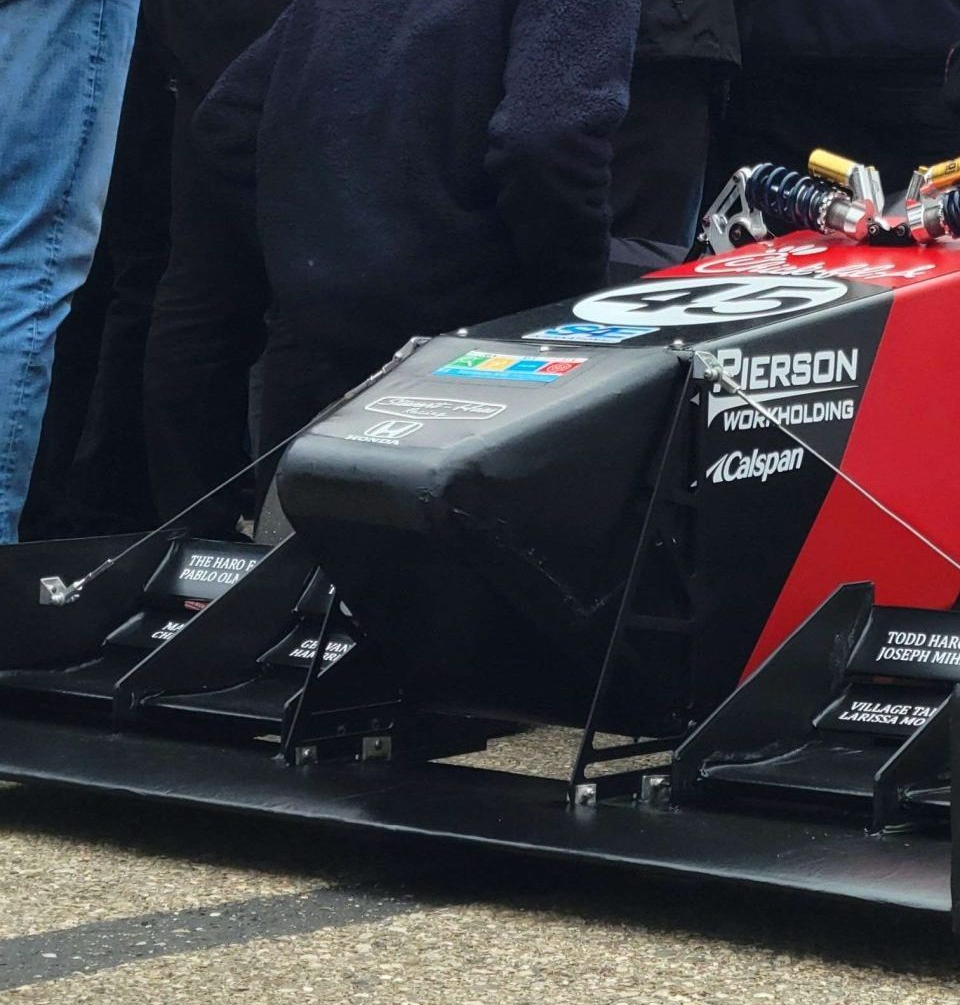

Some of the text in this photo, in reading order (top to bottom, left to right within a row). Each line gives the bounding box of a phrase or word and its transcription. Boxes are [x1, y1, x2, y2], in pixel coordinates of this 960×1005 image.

[596, 281, 833, 315] 45
[713, 349, 859, 393] PIERSON
[723, 399, 855, 432] WORKHOLDING
[345, 434, 400, 445] HONDA
[723, 447, 804, 482] Calspan
[189, 555, 213, 568] THE
[212, 557, 245, 571] HARO
[179, 569, 217, 582] PABLO
[887, 631, 927, 647] TODD
[876, 647, 930, 663] JOSEPH
[850, 701, 912, 716] VILLAGE
[838, 711, 898, 725] LARISSA
